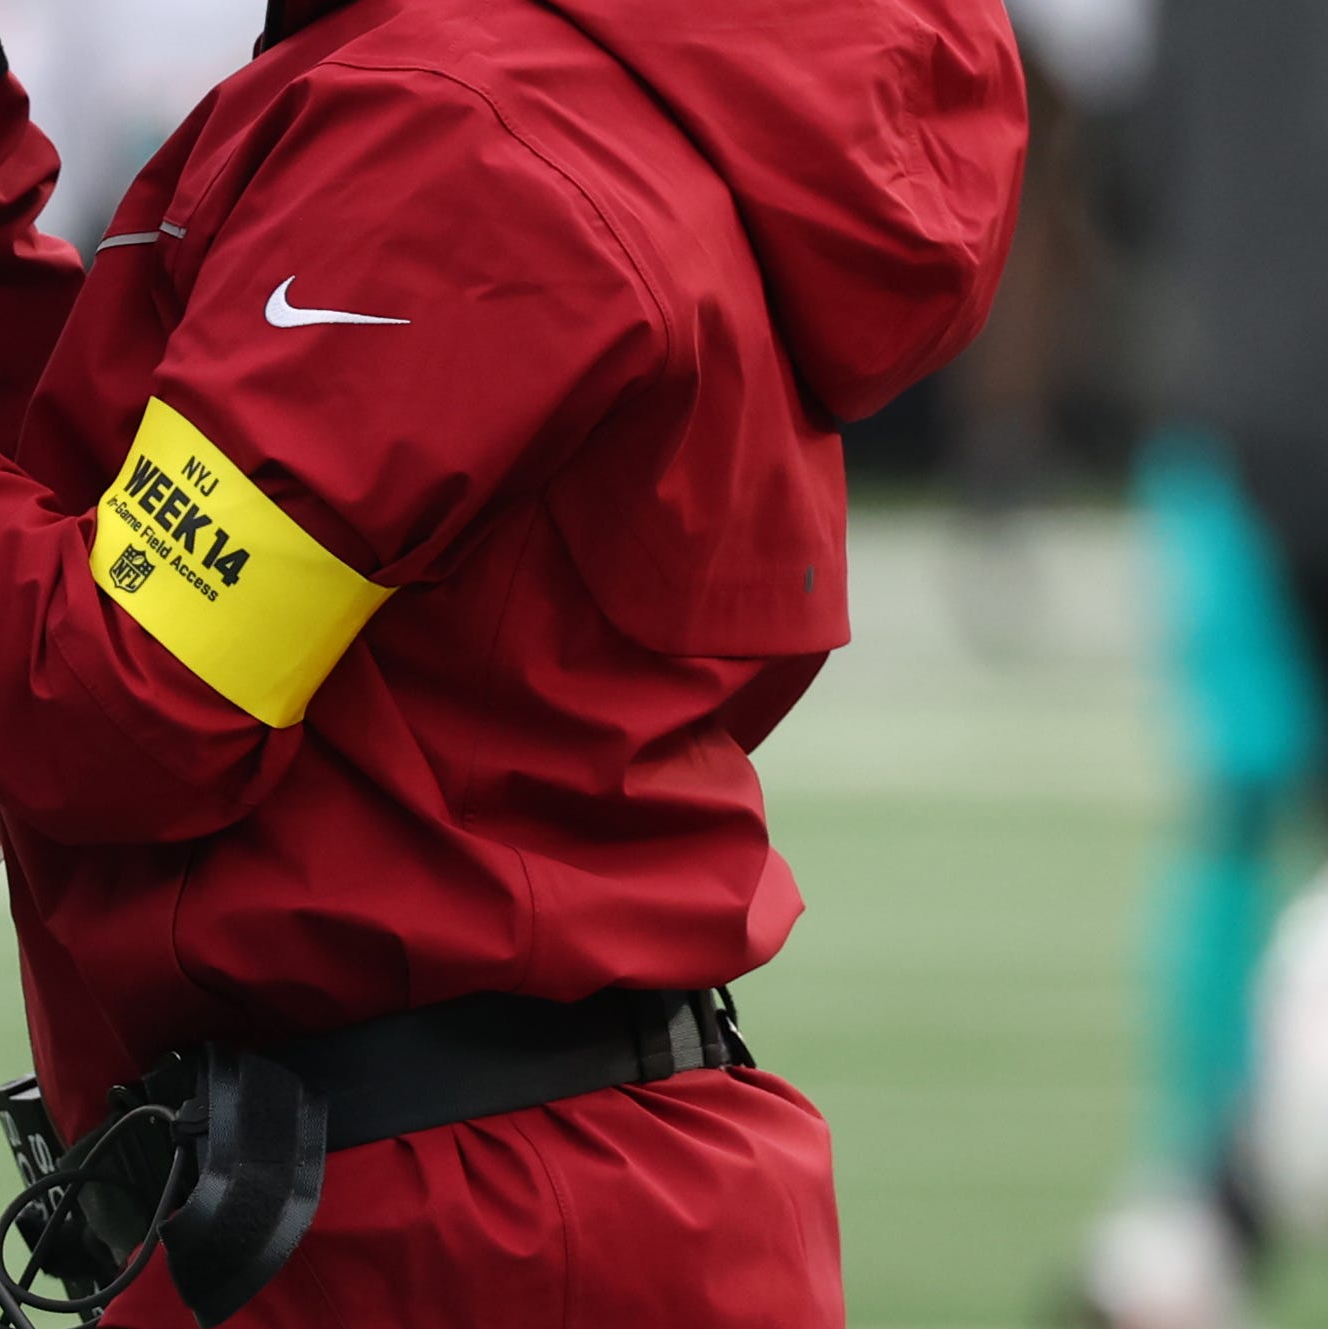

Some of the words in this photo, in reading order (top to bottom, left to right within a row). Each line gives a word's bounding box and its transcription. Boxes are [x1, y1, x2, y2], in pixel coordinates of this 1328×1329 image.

[181, 455, 219, 497] NYJ
[123, 454, 213, 555] WEEK
[201, 528, 251, 587] 14
[112, 559, 139, 591] NFL
[140, 525, 173, 560] Field
[169, 555, 219, 602] Access
